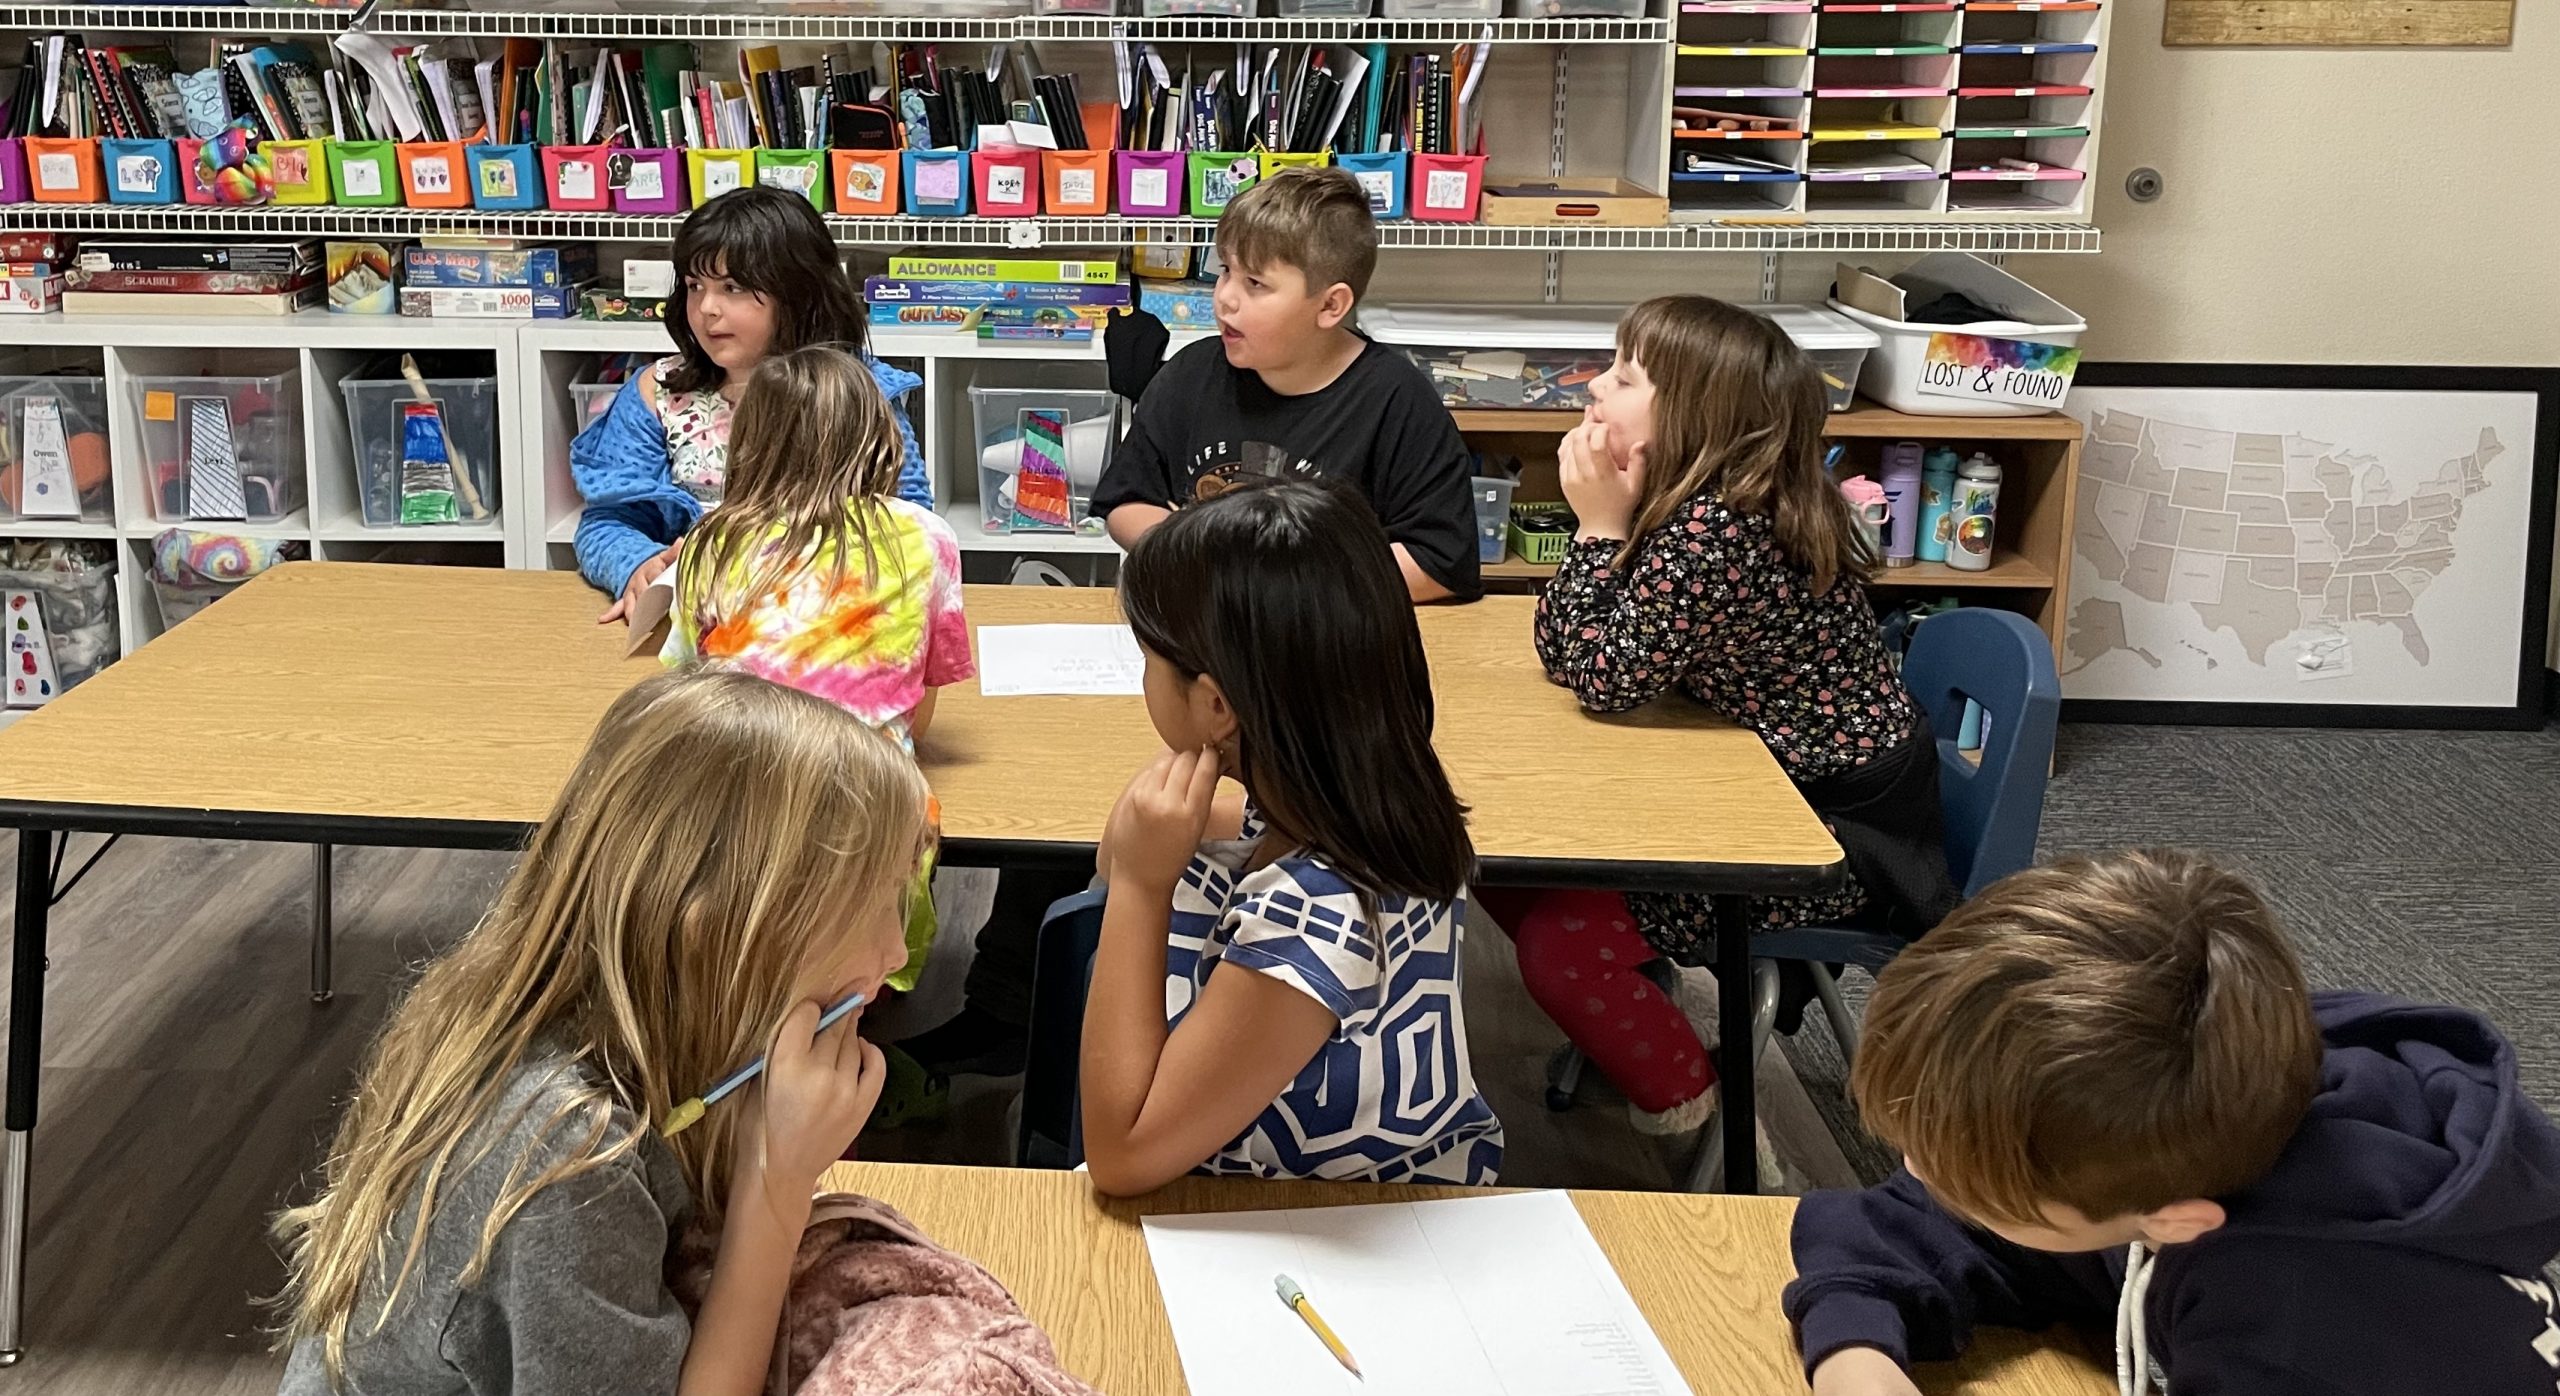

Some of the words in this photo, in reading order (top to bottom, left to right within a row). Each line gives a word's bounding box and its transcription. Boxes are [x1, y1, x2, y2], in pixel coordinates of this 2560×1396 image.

[409, 252, 442, 265] U.S.
[445, 252, 480, 268] Map
[896, 263, 997, 276] ALLOWANCE
[125, 276, 178, 287] SCRABBLE
[500, 294, 531, 305] 1000
[1924, 361, 1967, 387] LOST
[1973, 365, 1996, 393] &
[2004, 371, 2063, 400] FOUND
[33, 450, 58, 458] Owen
[1187, 441, 1227, 475] LIFE
